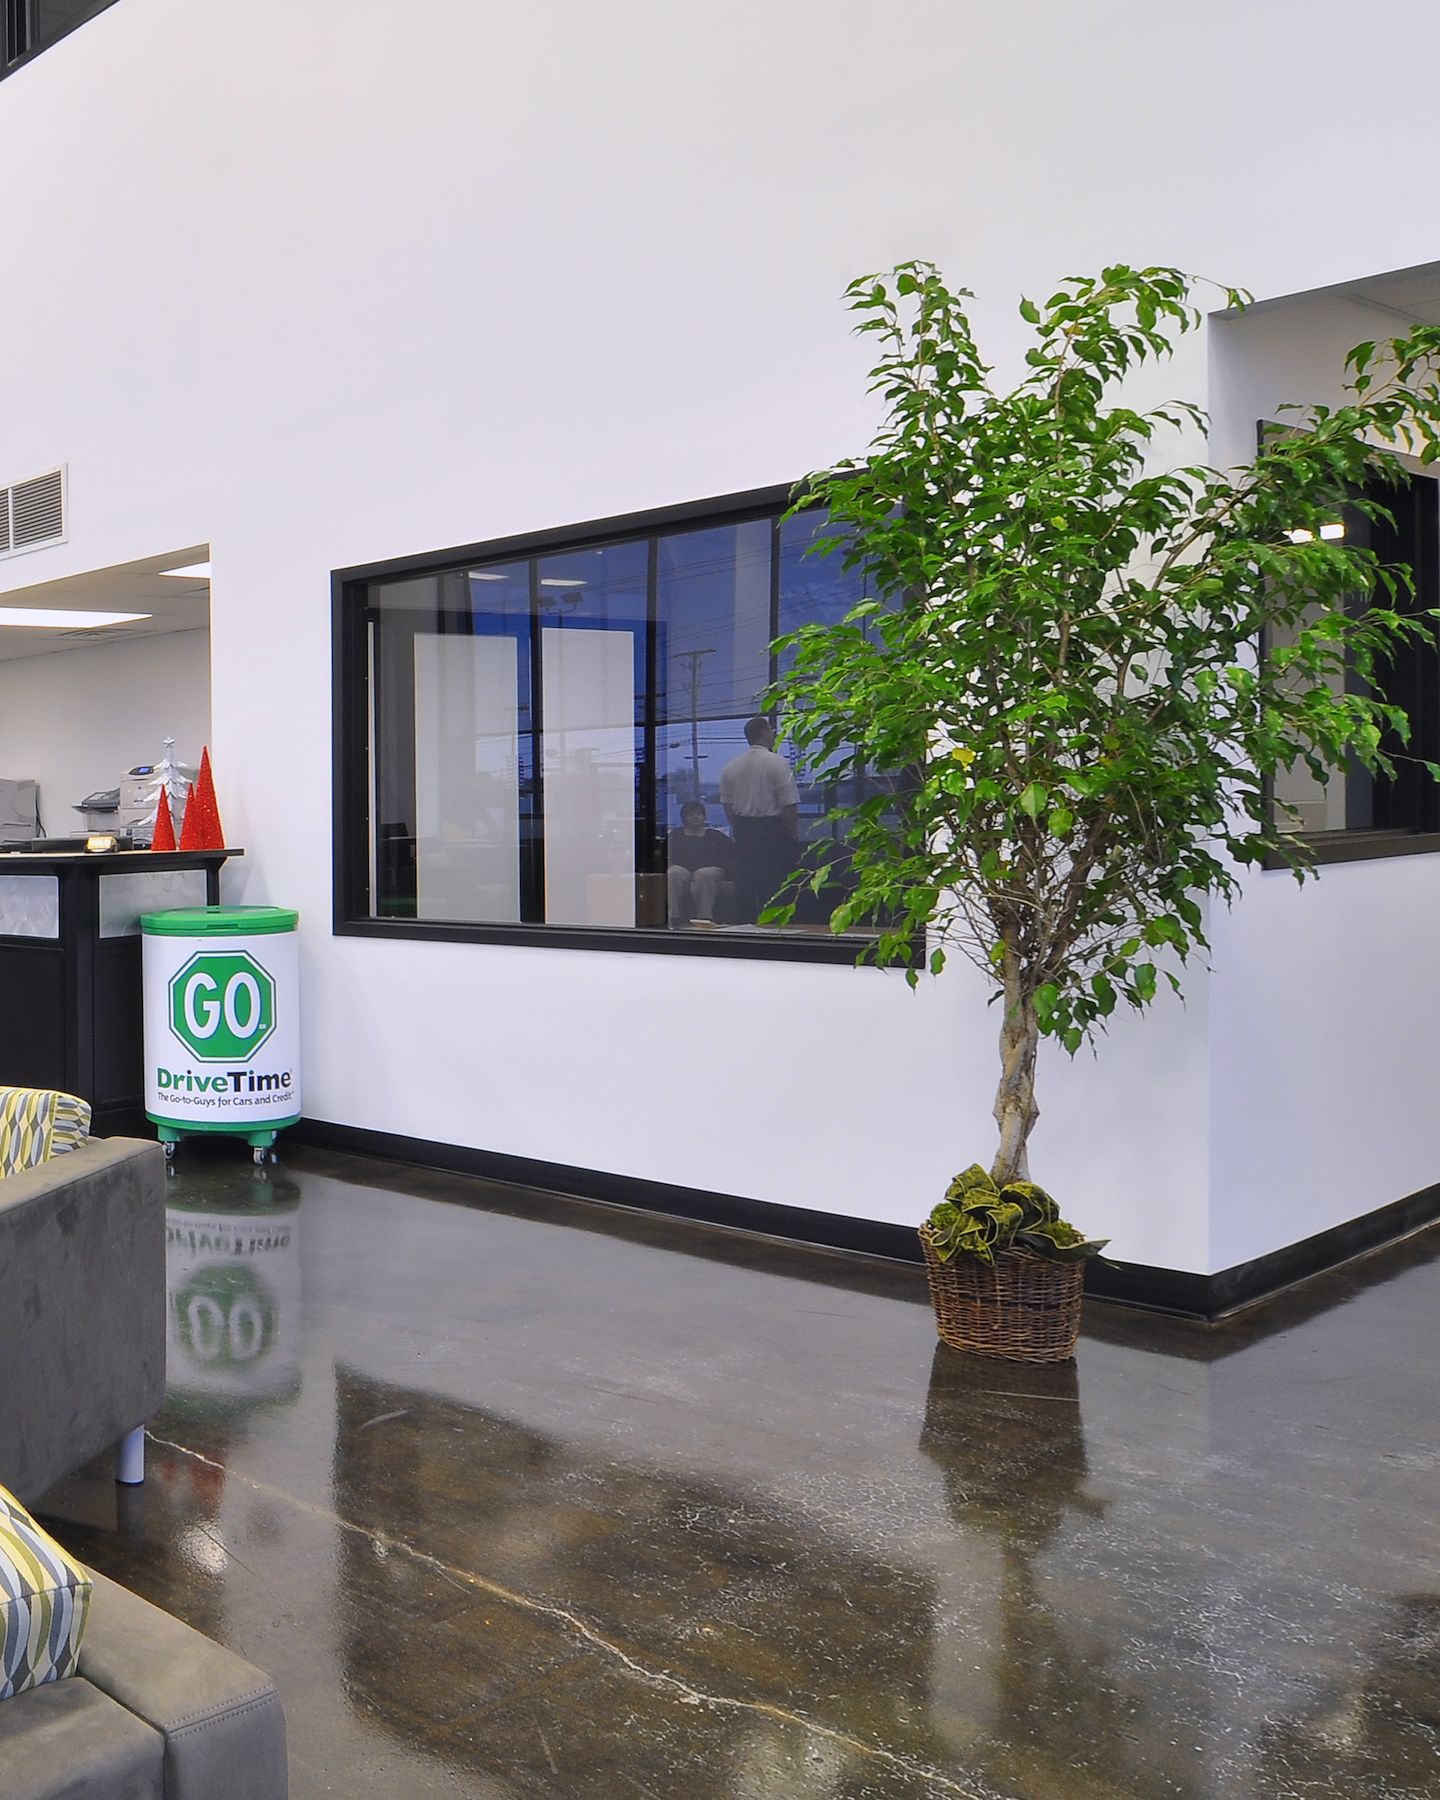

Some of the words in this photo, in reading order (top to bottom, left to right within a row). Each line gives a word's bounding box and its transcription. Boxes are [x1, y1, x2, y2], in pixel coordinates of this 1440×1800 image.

[184, 972, 261, 1039] GO
[157, 1067, 291, 1093] DriveTime
[158, 1092, 169, 1102] The
[170, 1095, 216, 1108] Go-to-Guys
[218, 1096, 231, 1108] for
[233, 1097, 253, 1106] Cars
[254, 1095, 271, 1105] and
